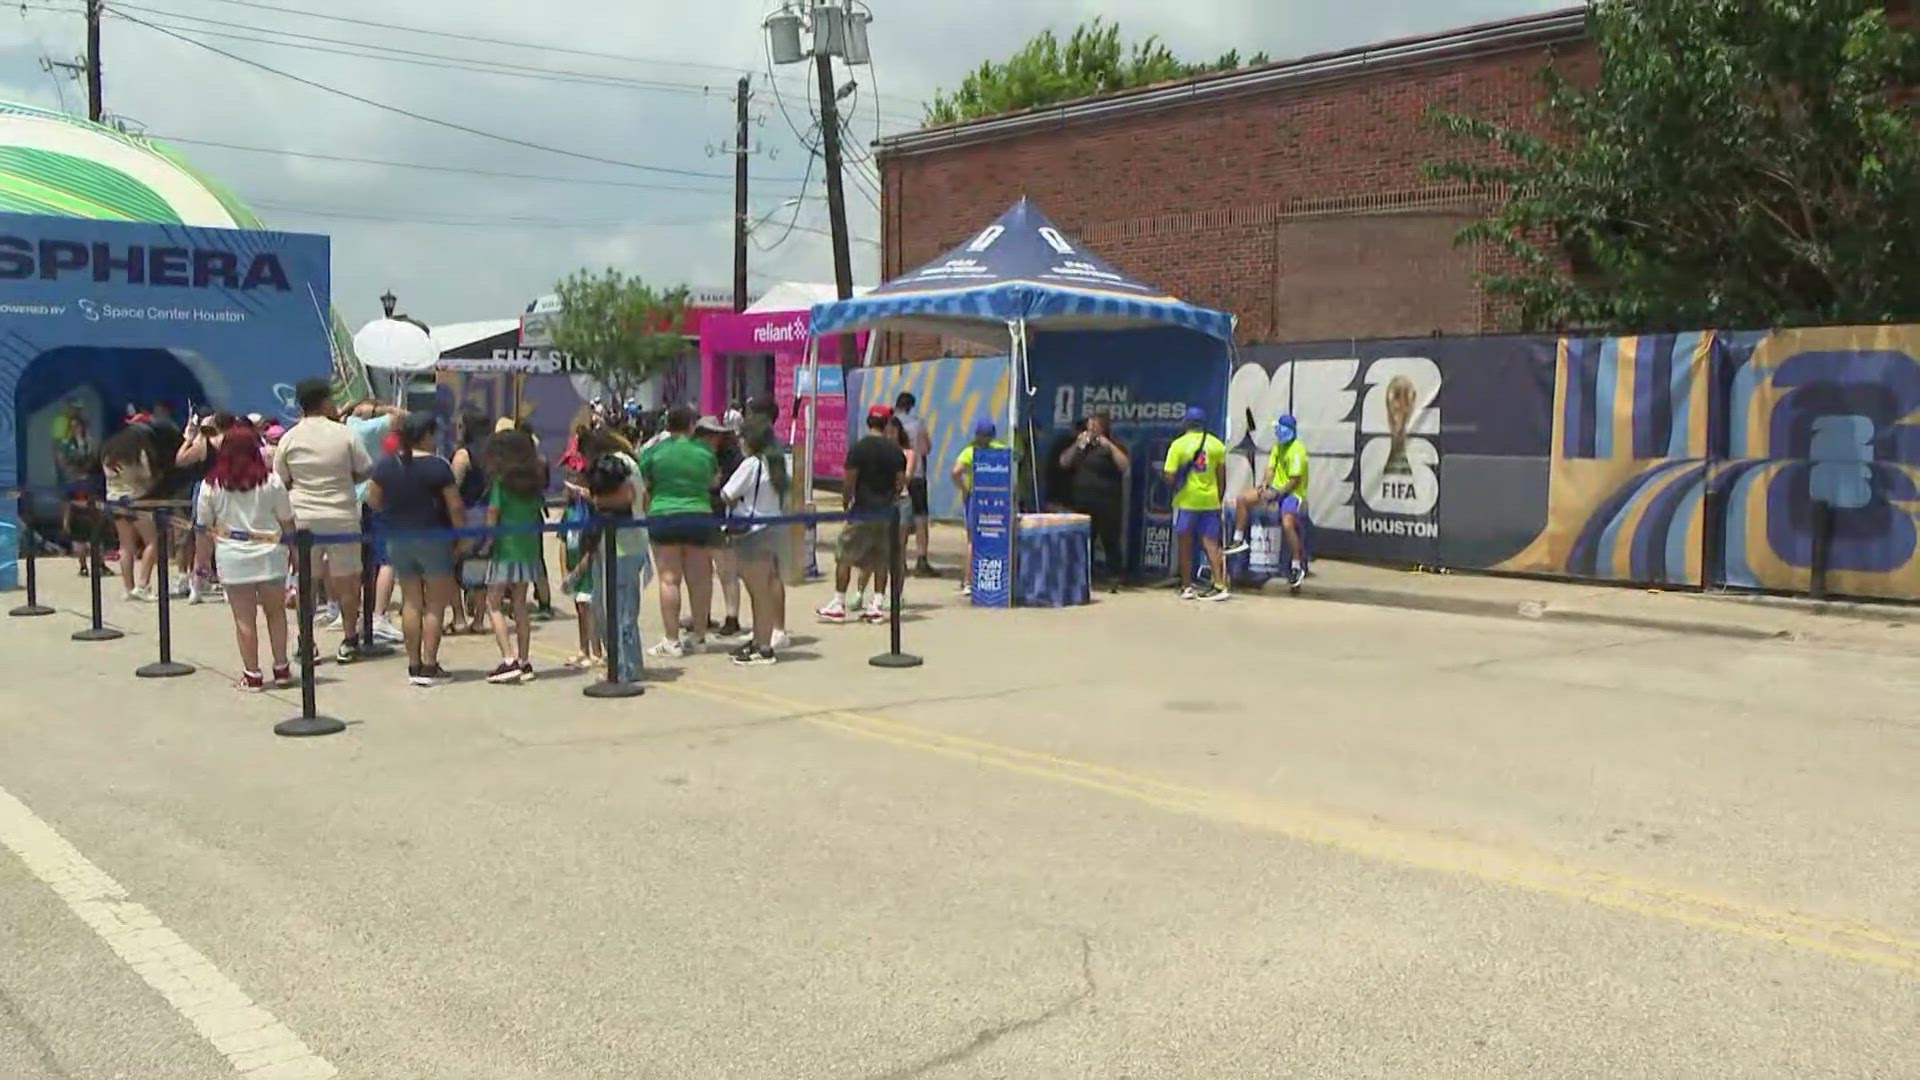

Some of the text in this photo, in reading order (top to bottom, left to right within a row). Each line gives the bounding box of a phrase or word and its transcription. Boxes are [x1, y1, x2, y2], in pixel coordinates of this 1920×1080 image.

[0, 304, 49, 315] OWERED
[102, 304, 246, 323] Space Center Houston
[754, 321, 793, 342] reliant
[1082, 385, 1128, 402] FAN
[1081, 402, 1187, 420] SERVICES
[1382, 481, 1417, 501] FIFA
[1361, 517, 1439, 539] HOUSTON
